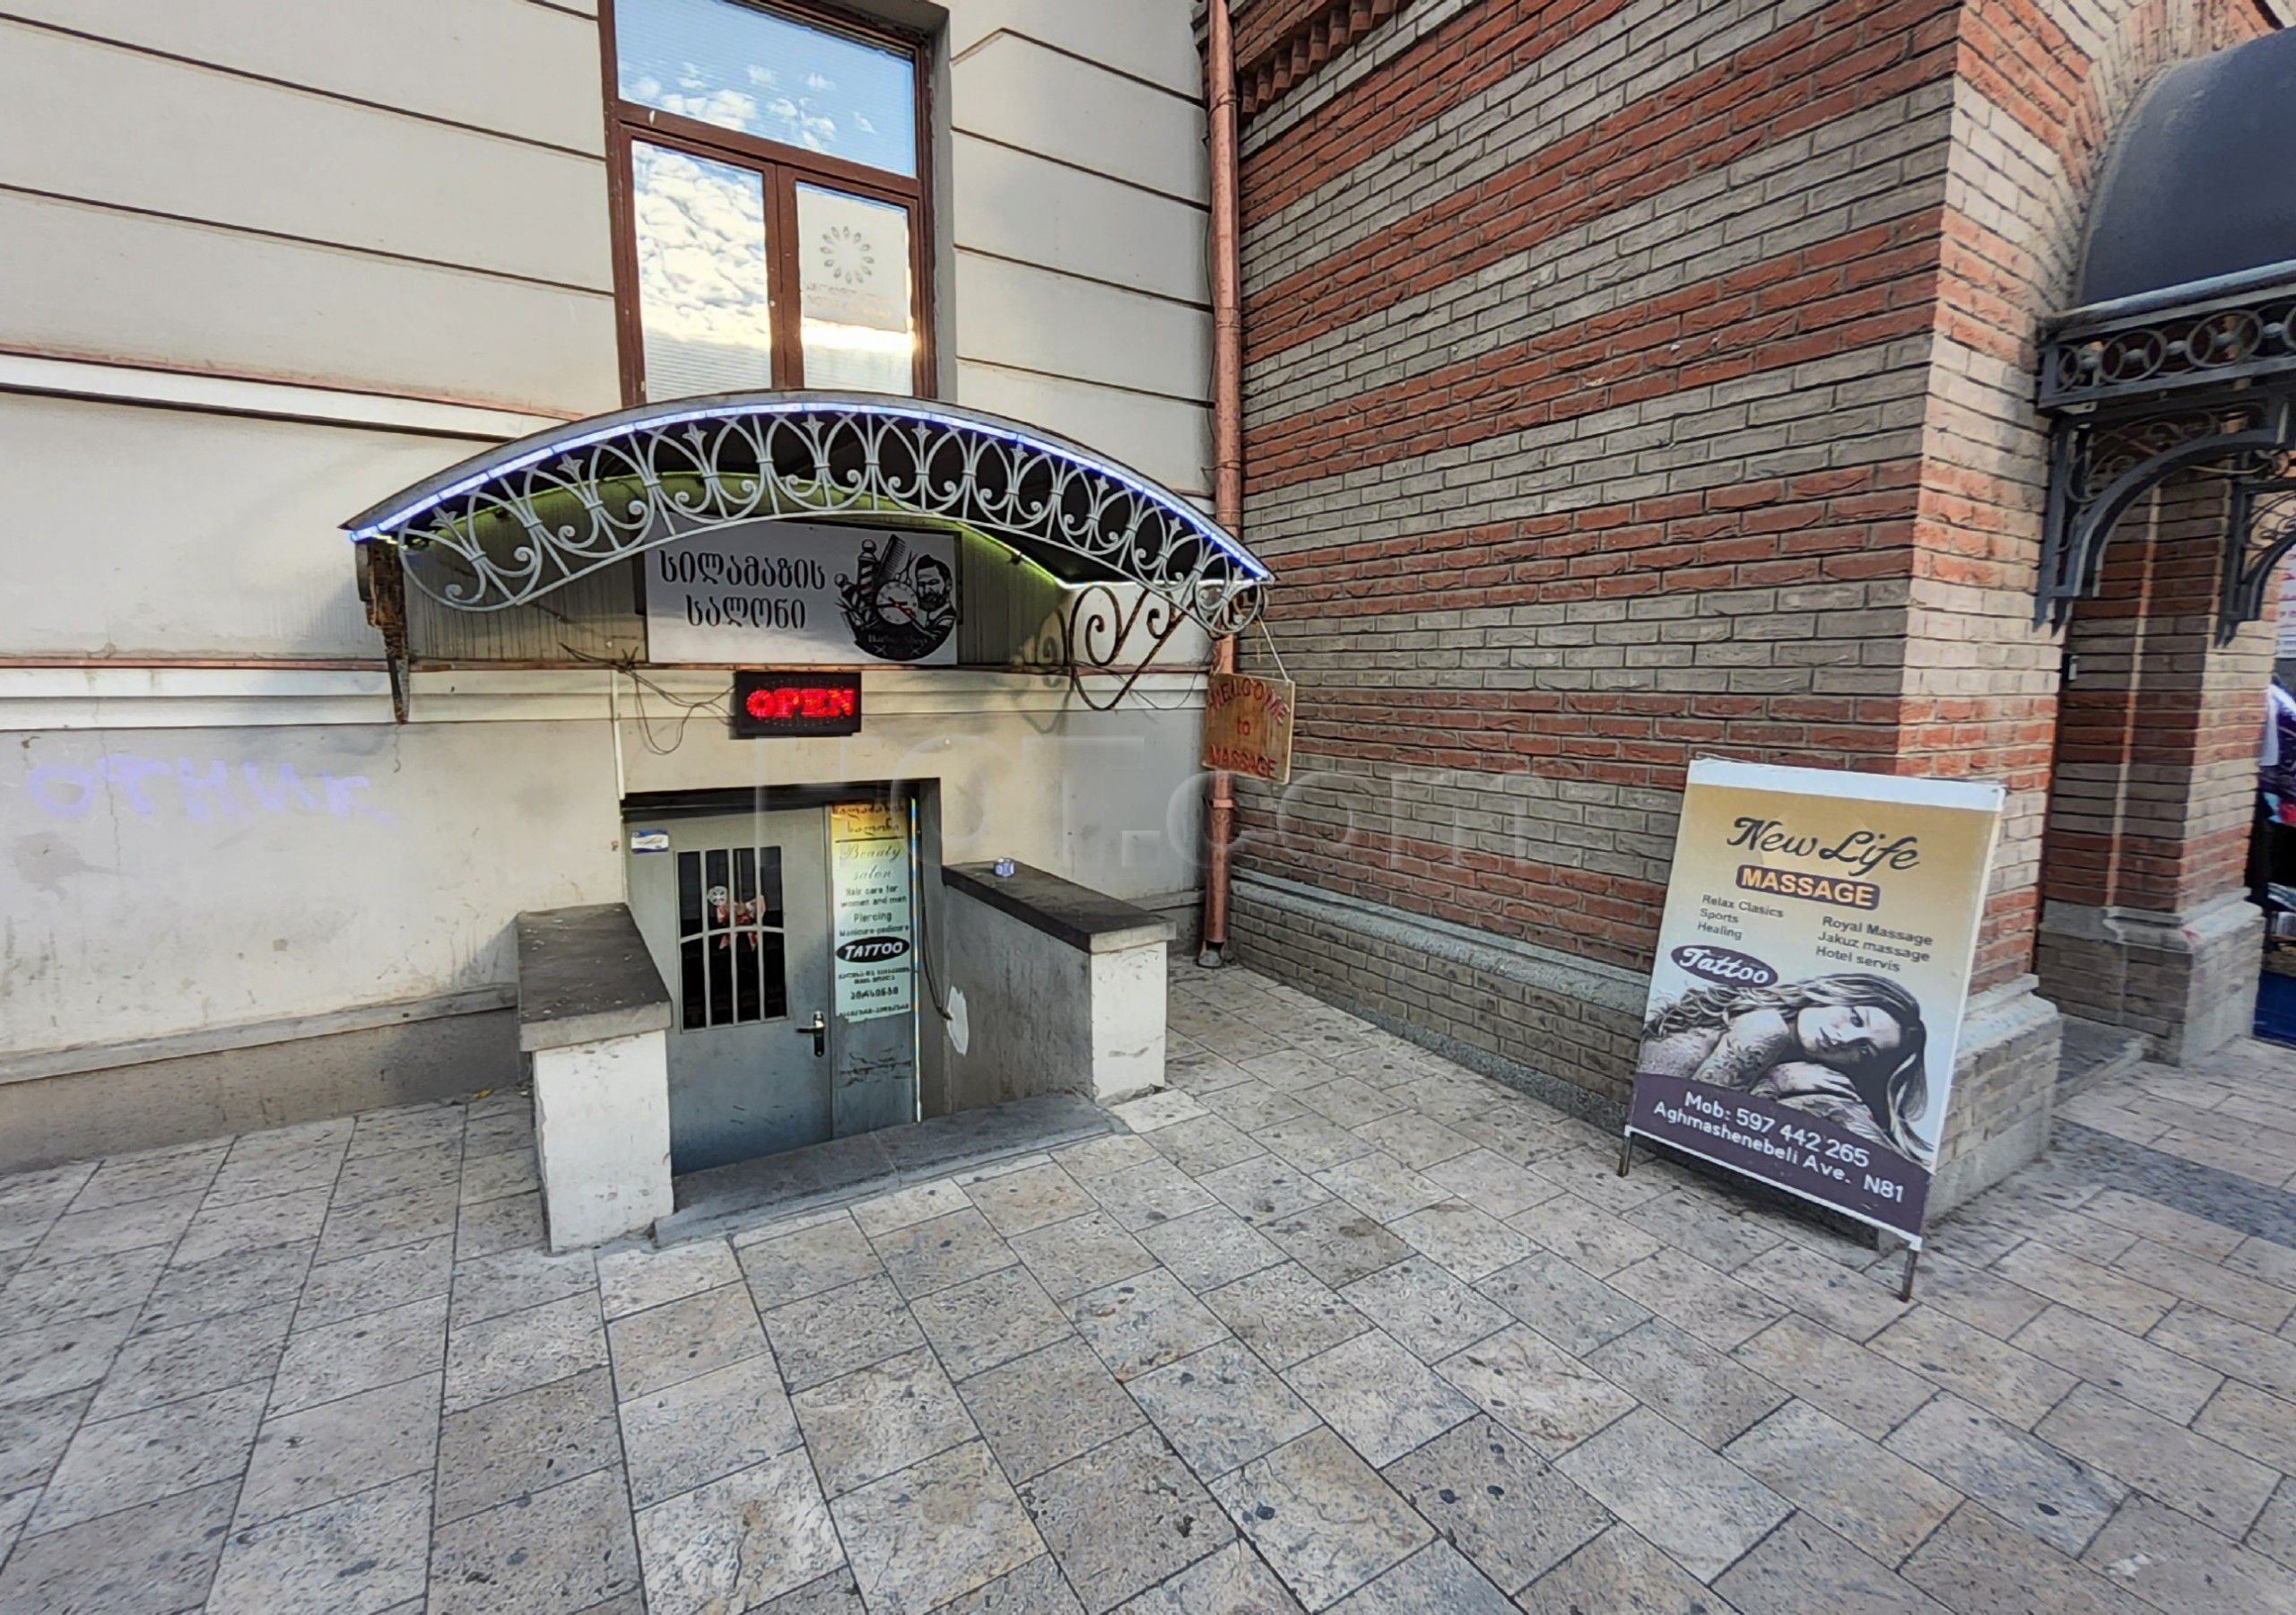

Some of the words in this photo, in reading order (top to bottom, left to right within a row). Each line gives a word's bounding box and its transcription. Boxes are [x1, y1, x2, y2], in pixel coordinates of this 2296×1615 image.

[659, 550, 826, 590] სილამაზის
[685, 595, 806, 629] სალონი
[746, 688, 855, 720] OPEN
[1208, 678, 1291, 725] WELCOME
[1238, 717, 1251, 735] to
[1208, 744, 1278, 778] MASSAGE
[839, 844, 901, 863] Beauty
[1726, 816, 1818, 856] New
[1819, 830, 1919, 877] Life
[855, 864, 891, 880] salon
[865, 886, 883, 895] care
[886, 884, 898, 893] for
[873, 897, 888, 906] and
[890, 895, 907, 903] men
[1741, 868, 1874, 907] MASSAGE
[854, 913, 892, 923] Piercing
[1700, 908, 1739, 925] Sports
[1702, 895, 1735, 909] Relax
[1738, 900, 1784, 918] Clasics
[1697, 922, 1743, 941] Healing
[1822, 916, 1863, 935] Royal
[1866, 925, 1934, 946] Massage
[845, 941, 903, 960] TATTOO
[1815, 946, 1853, 963] Hotel
[1857, 954, 1900, 973] servis
[1817, 931, 1859, 949] Jakuz
[1863, 941, 1930, 963] massage
[1679, 947, 1770, 984] Tattoo
[1684, 1091, 1731, 1120] Mob:
[1735, 1107, 1776, 1133] 597
[1779, 1124, 1822, 1152] 442
[1823, 1138, 1871, 1168] 265
[1654, 1101, 1798, 1164] Aghmashenebeli
[1803, 1154, 1851, 1184] Ave.
[1864, 1173, 1904, 1203] N81
